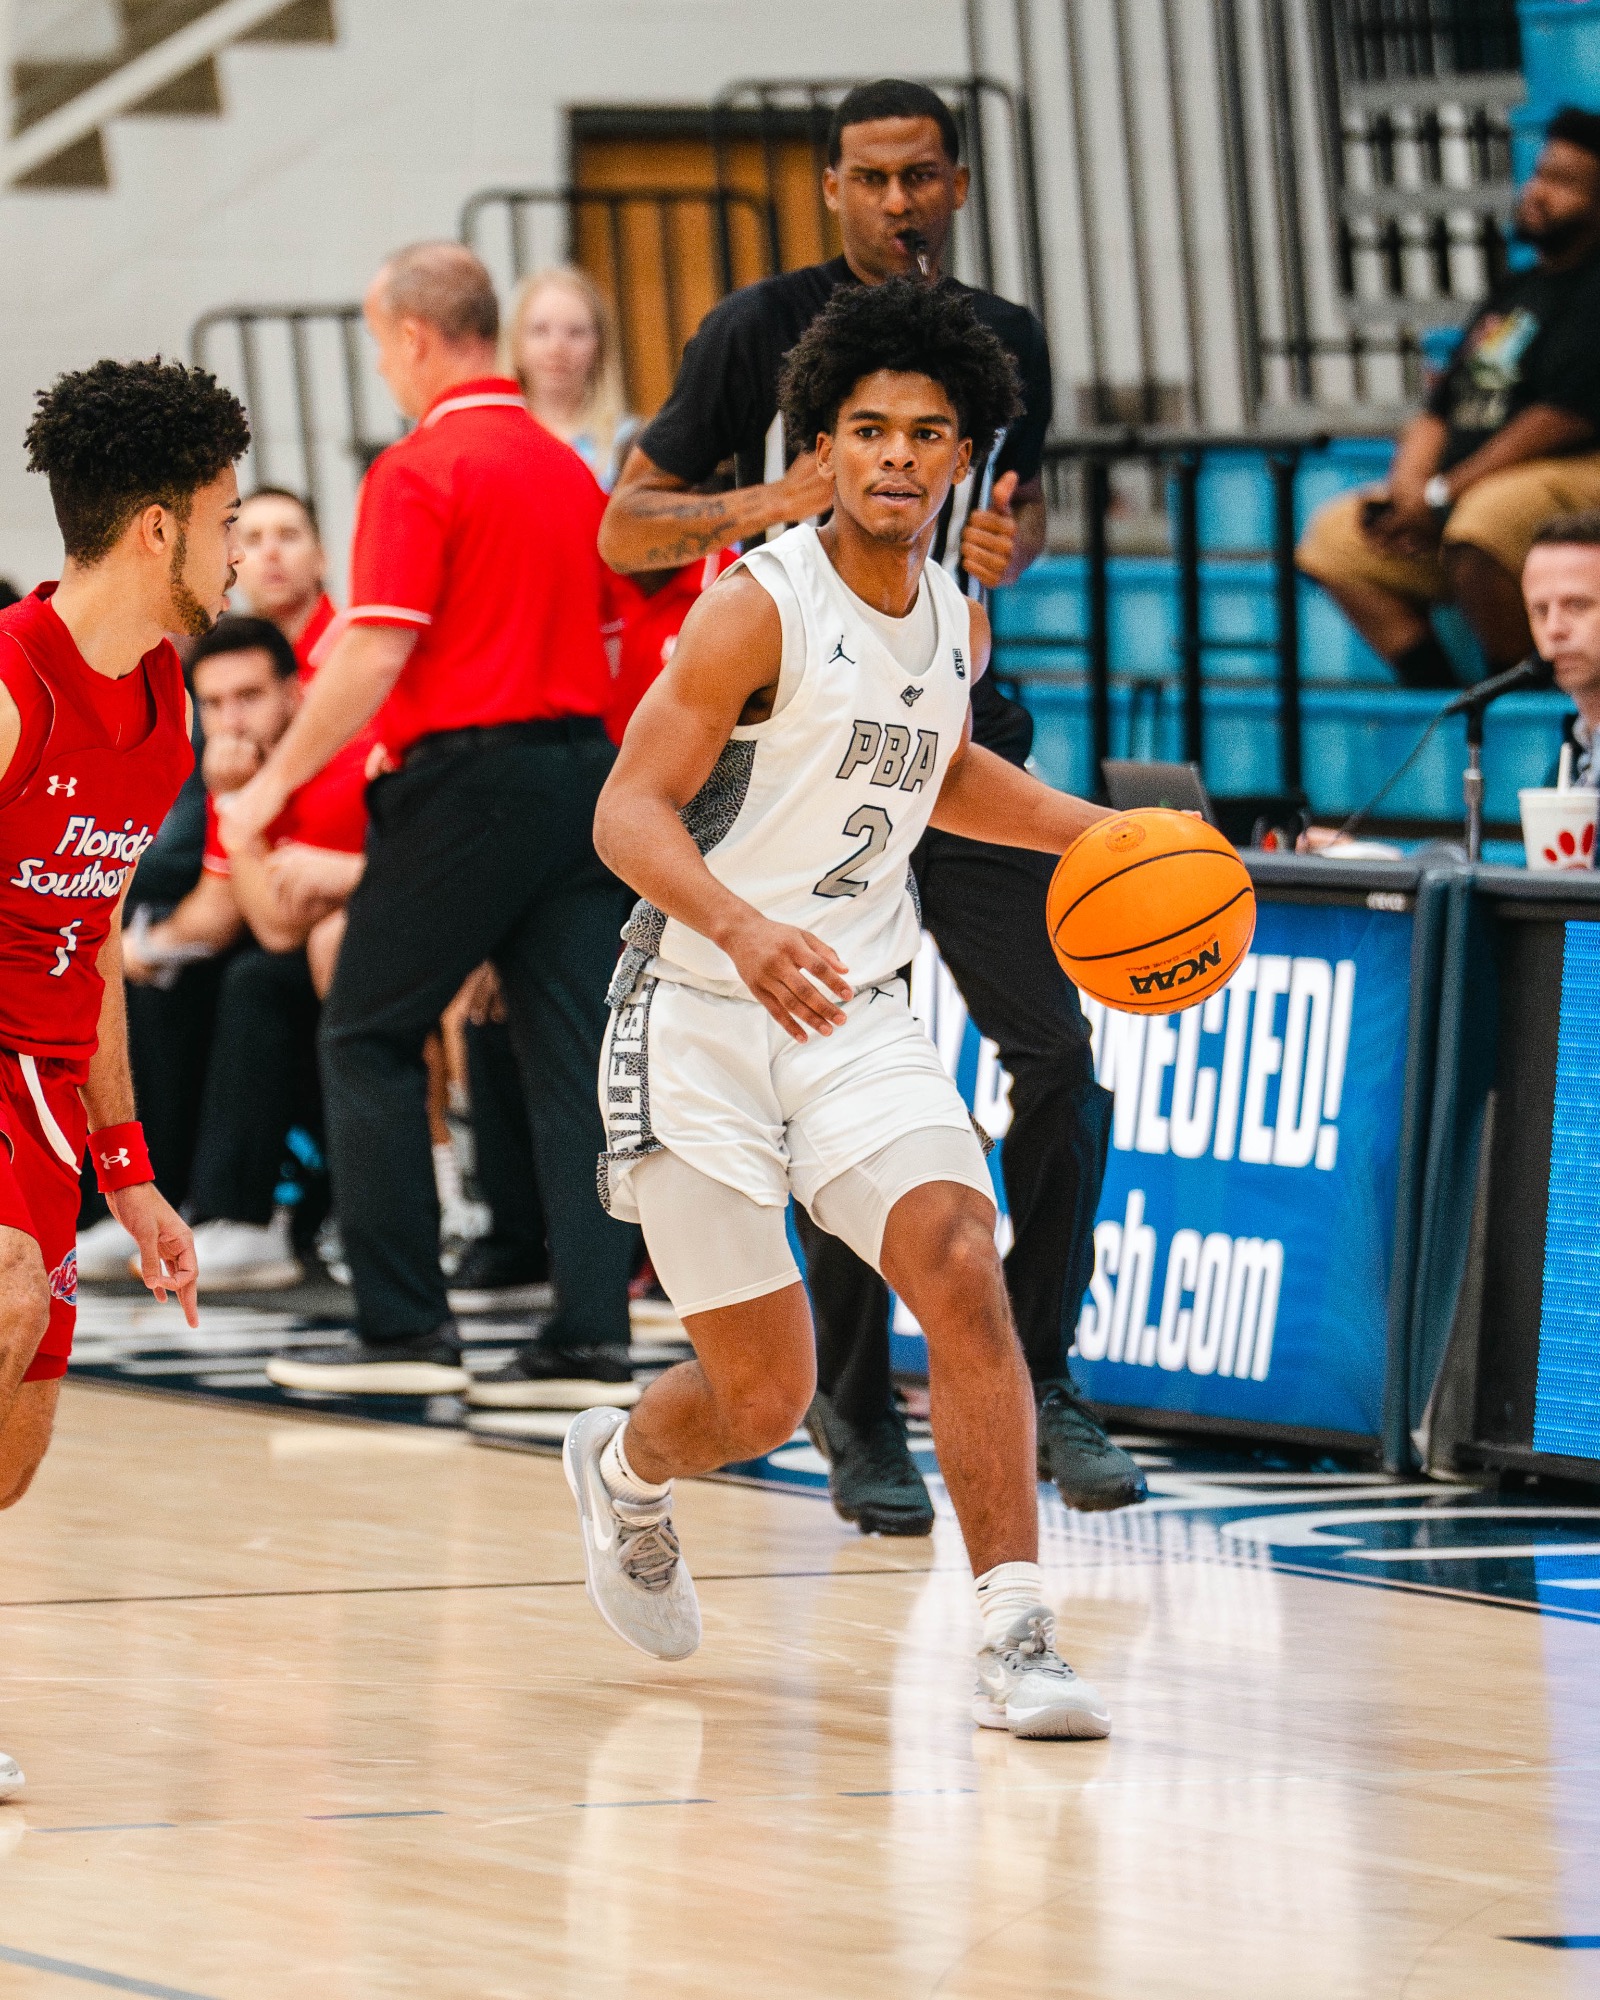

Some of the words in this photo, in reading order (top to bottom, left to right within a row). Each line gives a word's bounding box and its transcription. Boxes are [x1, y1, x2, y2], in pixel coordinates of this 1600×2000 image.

[835, 719, 938, 794] PBA
[10, 858, 129, 898] Souther
[812, 804, 893, 898] 2
[1128, 940, 1222, 995] NCAA
